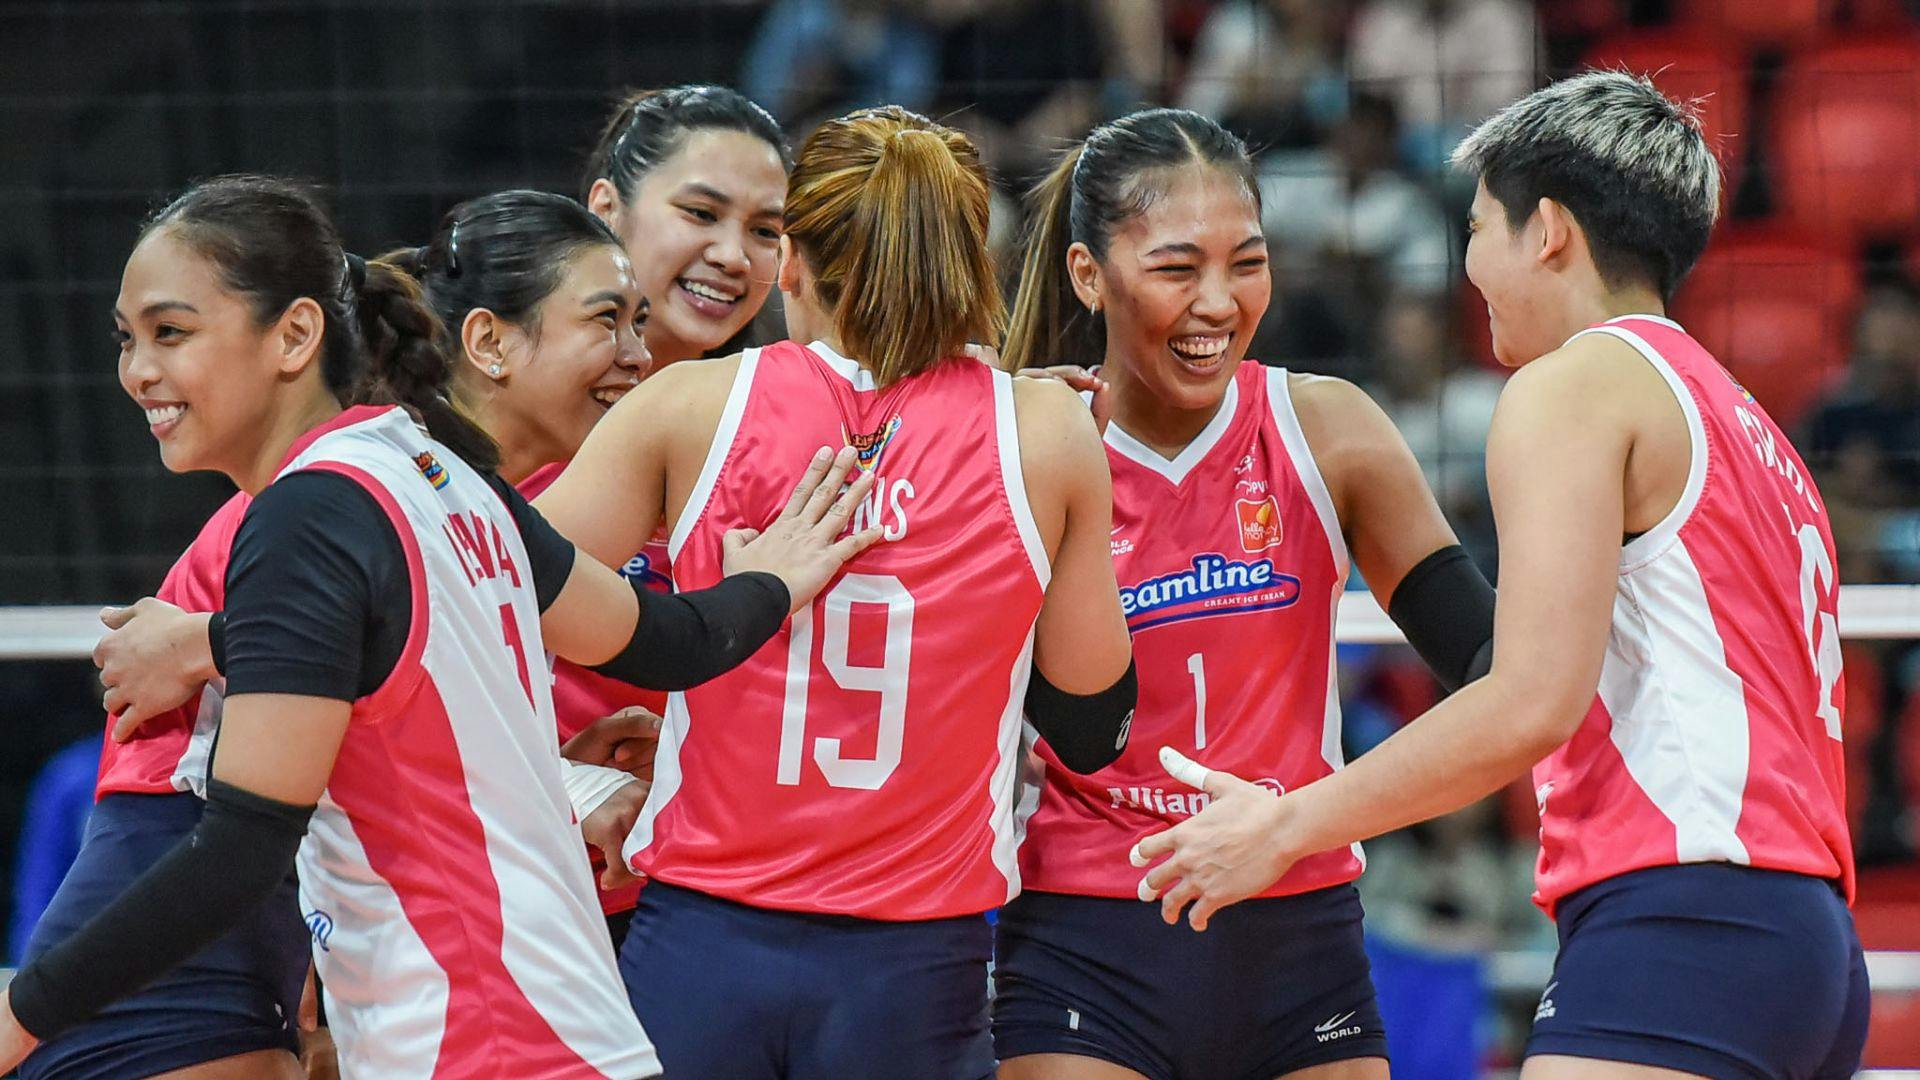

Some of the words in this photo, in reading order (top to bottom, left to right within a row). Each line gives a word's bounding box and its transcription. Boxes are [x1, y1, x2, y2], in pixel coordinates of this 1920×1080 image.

[1119, 559, 1270, 614] eamline
[1204, 597, 1240, 608] CREAMY
[1243, 595, 1258, 604] ICE
[1261, 591, 1285, 601] CREAM
[499, 602, 537, 716] 1
[777, 573, 915, 790] 19
[1187, 653, 1206, 750] 1
[1107, 787, 1210, 815] Allian
[1316, 1026, 1361, 1042] WORLD
